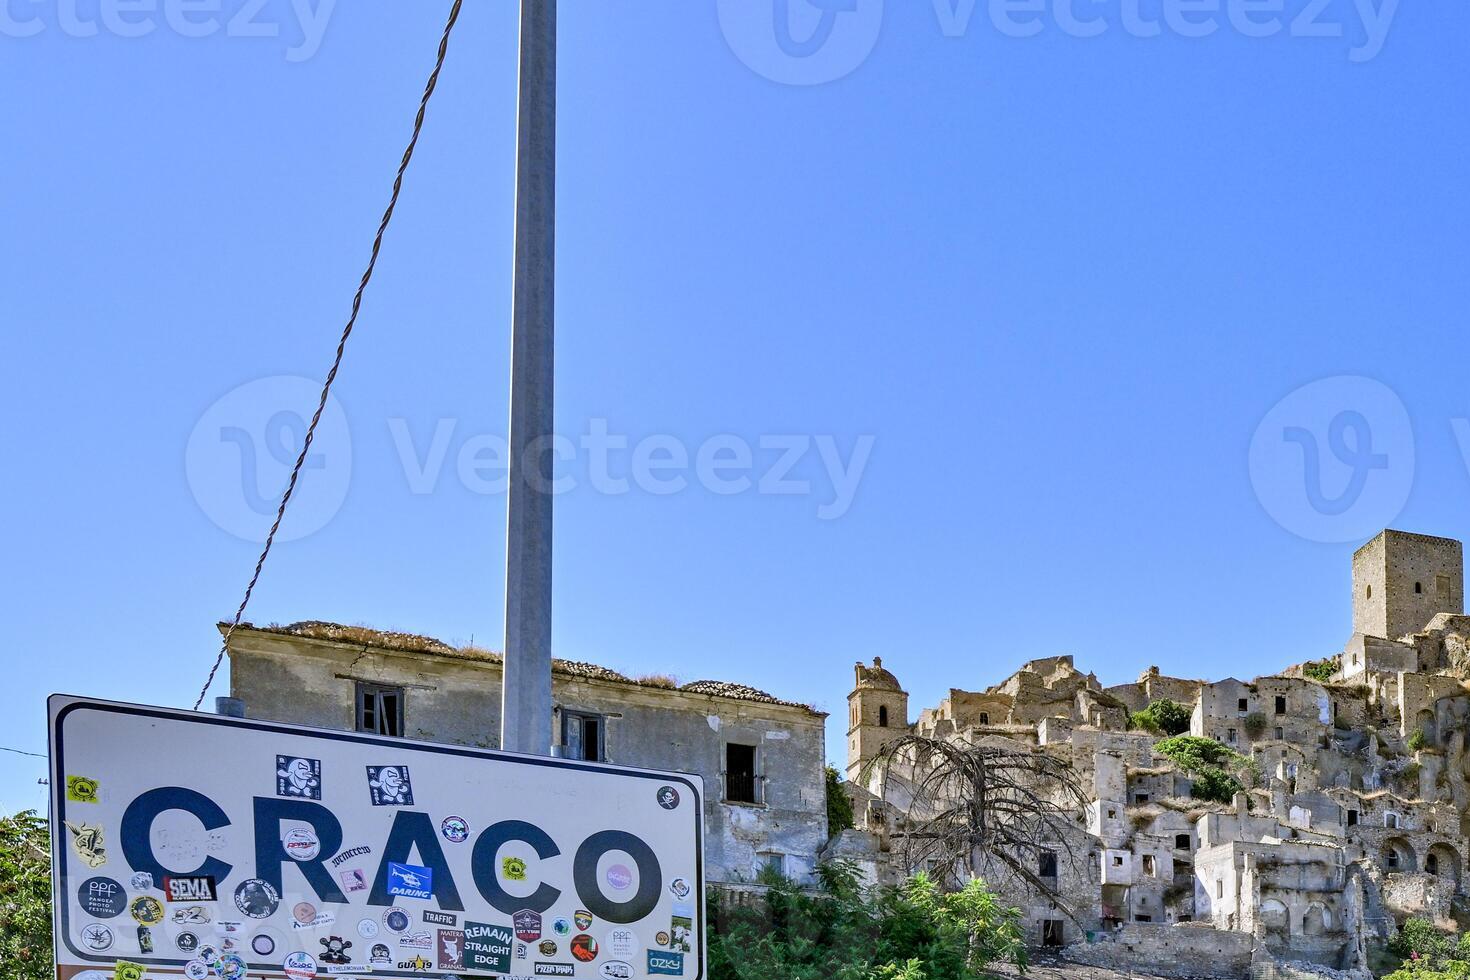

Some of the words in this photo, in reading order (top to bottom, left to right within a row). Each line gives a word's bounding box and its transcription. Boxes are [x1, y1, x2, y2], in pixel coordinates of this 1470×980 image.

[120, 786, 662, 924] CRACO
[169, 878, 212, 896] SEMA
[391, 886, 430, 898] DARING
[425, 912, 453, 924] TRAFFIC
[440, 930, 464, 938] MATERA
[465, 925, 513, 945] REMAIN
[464, 941, 510, 956] STRAIGHT
[474, 955, 499, 966] EDGE
